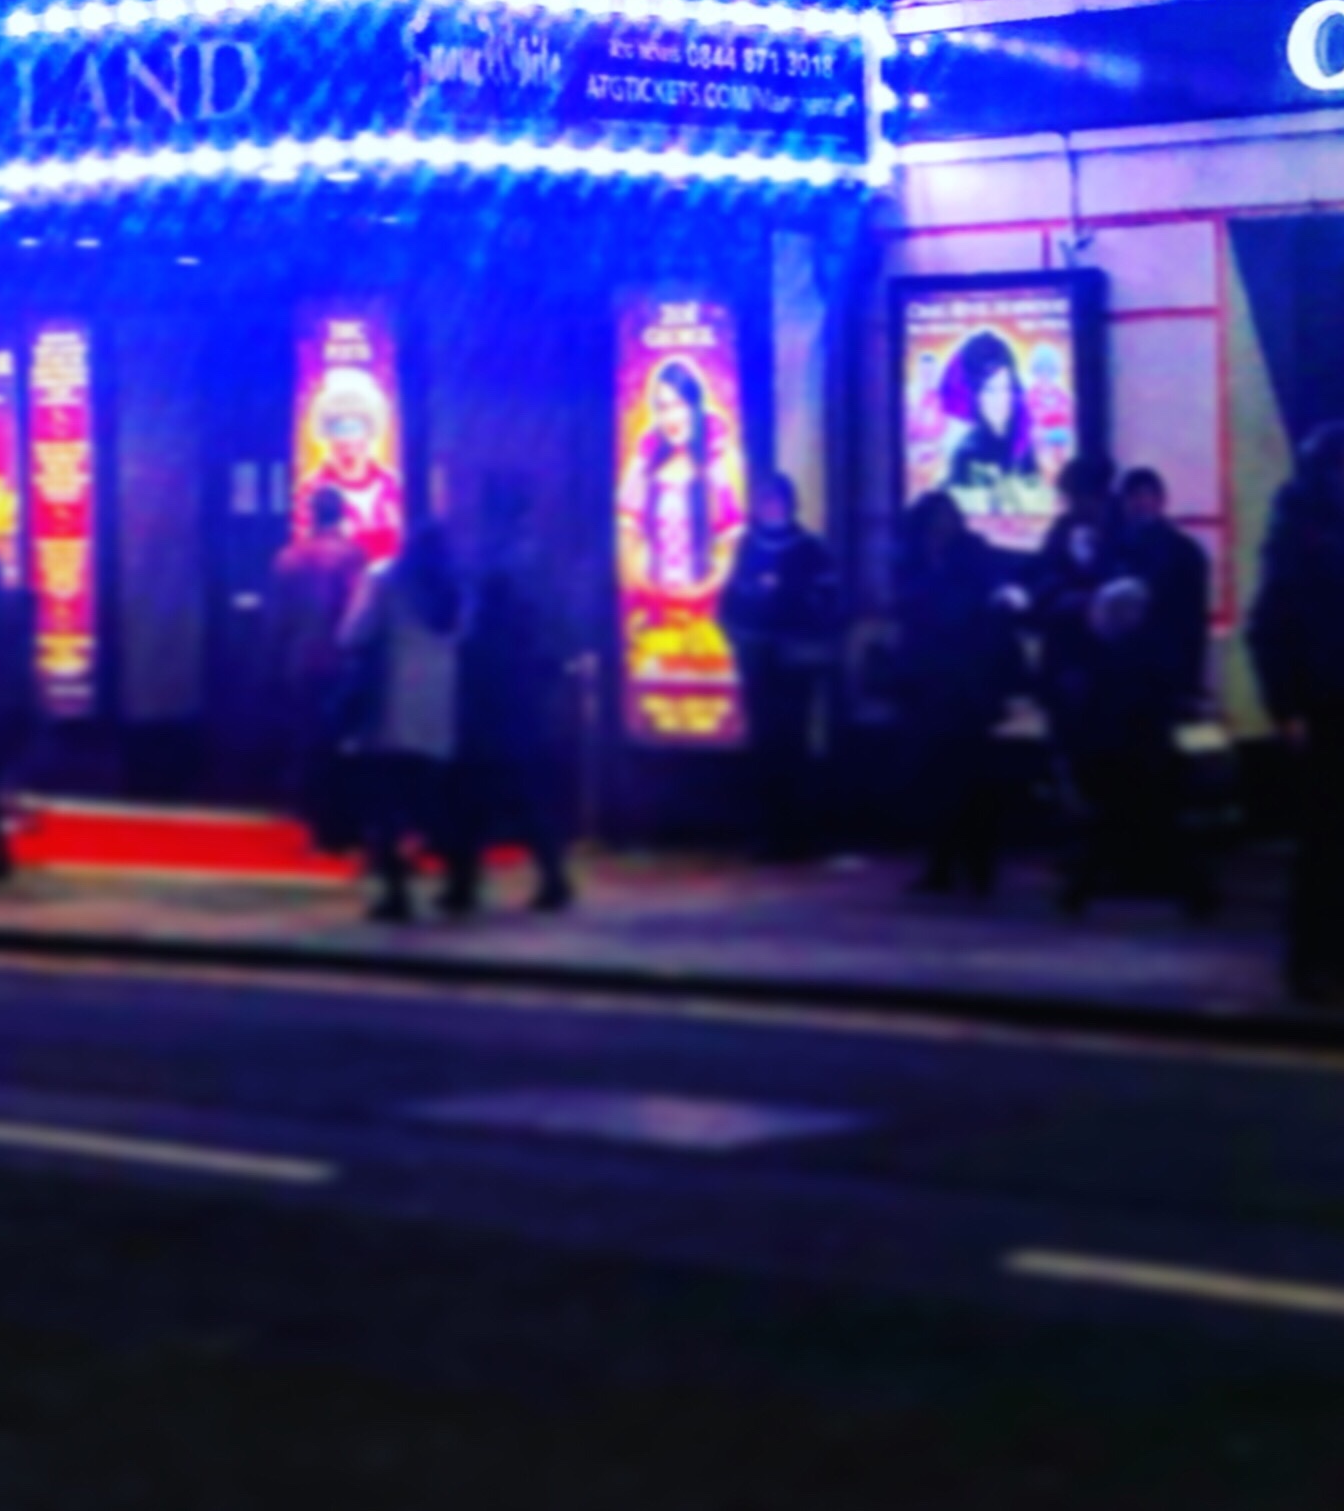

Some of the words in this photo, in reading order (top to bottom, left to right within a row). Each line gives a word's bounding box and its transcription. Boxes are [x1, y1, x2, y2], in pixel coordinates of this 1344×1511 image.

[16, 40, 258, 138] LAND
[686, 41, 737, 71] 0844
[743, 46, 780, 75] 871
[786, 50, 836, 79] 3018
